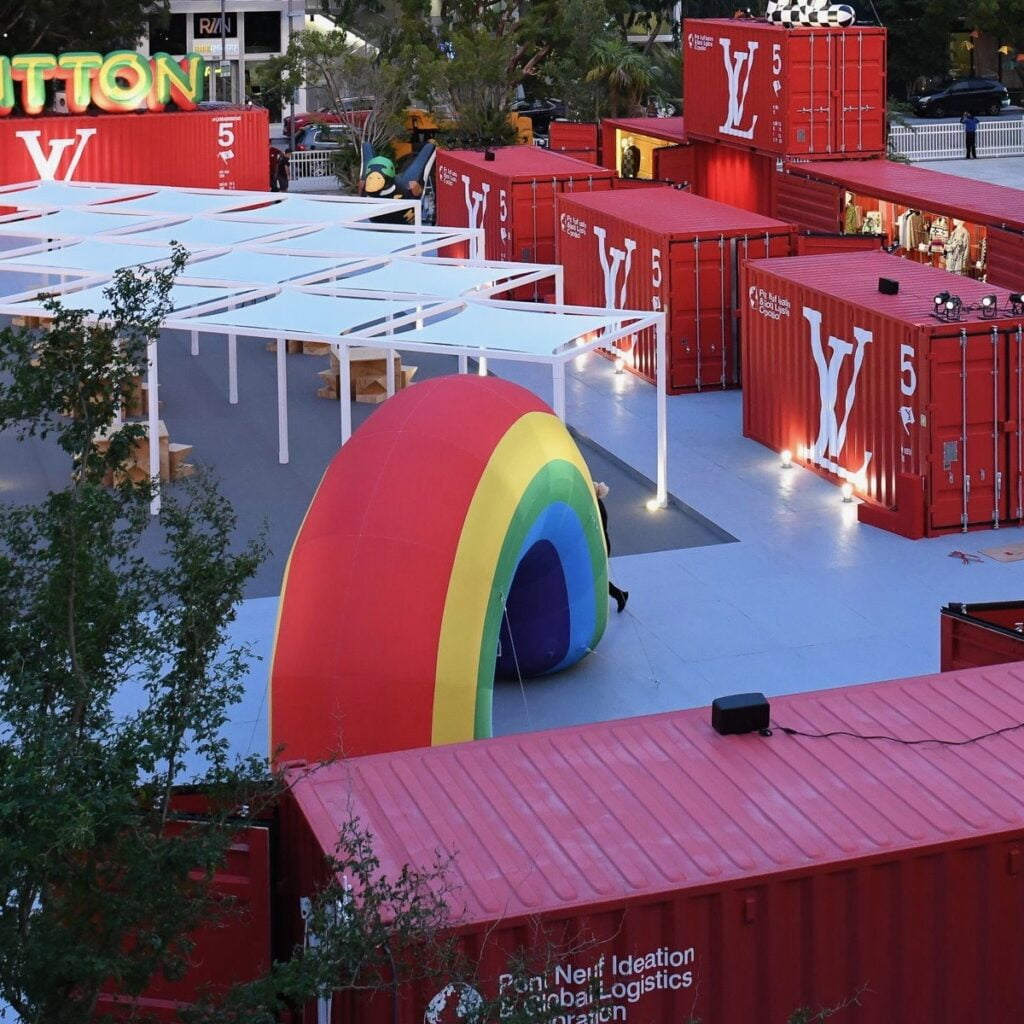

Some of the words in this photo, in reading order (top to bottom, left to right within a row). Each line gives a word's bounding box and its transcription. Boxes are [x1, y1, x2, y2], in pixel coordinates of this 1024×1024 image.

[719, 38, 759, 140] LV
[772, 44, 782, 75] 5
[218, 122, 235, 147] 5
[499, 189, 508, 222] 5
[651, 248, 662, 288] 5
[803, 306, 873, 489] LV
[900, 343, 917, 396] 5
[555, 953, 605, 985] Neuf
[612, 946, 695, 976] Ideation
[600, 969, 693, 1003] Logistics
